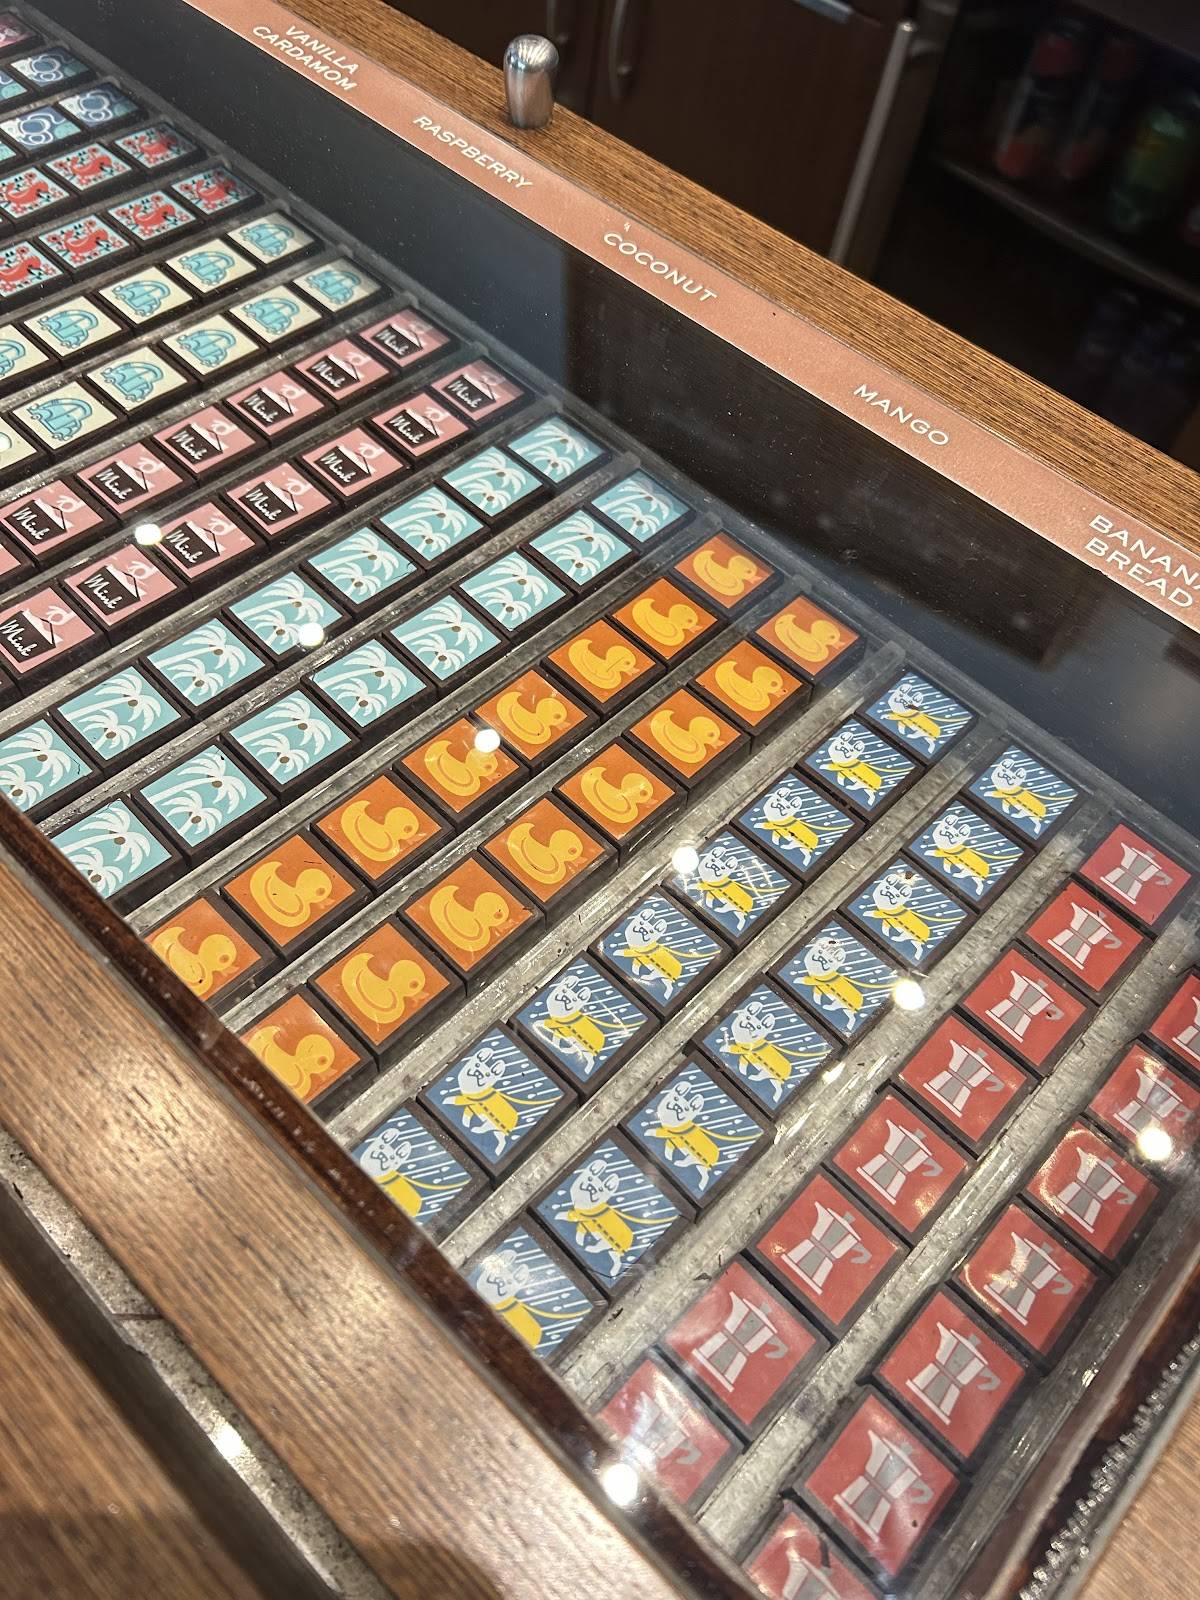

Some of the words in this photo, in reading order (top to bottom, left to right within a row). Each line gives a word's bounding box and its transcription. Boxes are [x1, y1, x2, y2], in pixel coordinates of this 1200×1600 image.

[252, 26, 358, 91] CARDAMOM
[285, 25, 359, 75] VANILLA
[412, 116, 533, 188] RASPBERRY
[603, 233, 718, 301] COCONUT
[376, 329, 410, 356] Mink
[311, 360, 345, 388] Mink
[243, 394, 278, 423] Mink
[447, 379, 483, 409] Mink
[389, 415, 425, 444] Mink
[853, 384, 949, 446] MANGO
[171, 430, 208, 460] Mink
[96, 468, 132, 500] Mink
[321, 452, 357, 483] Mink
[245, 488, 282, 521] Mink
[12, 507, 50, 541] Mink
[166, 529, 203, 563] Mink
[1085, 537, 1193, 607] BREAD
[84, 573, 123, 609] Mink
[0, 619, 38, 657] Mink
